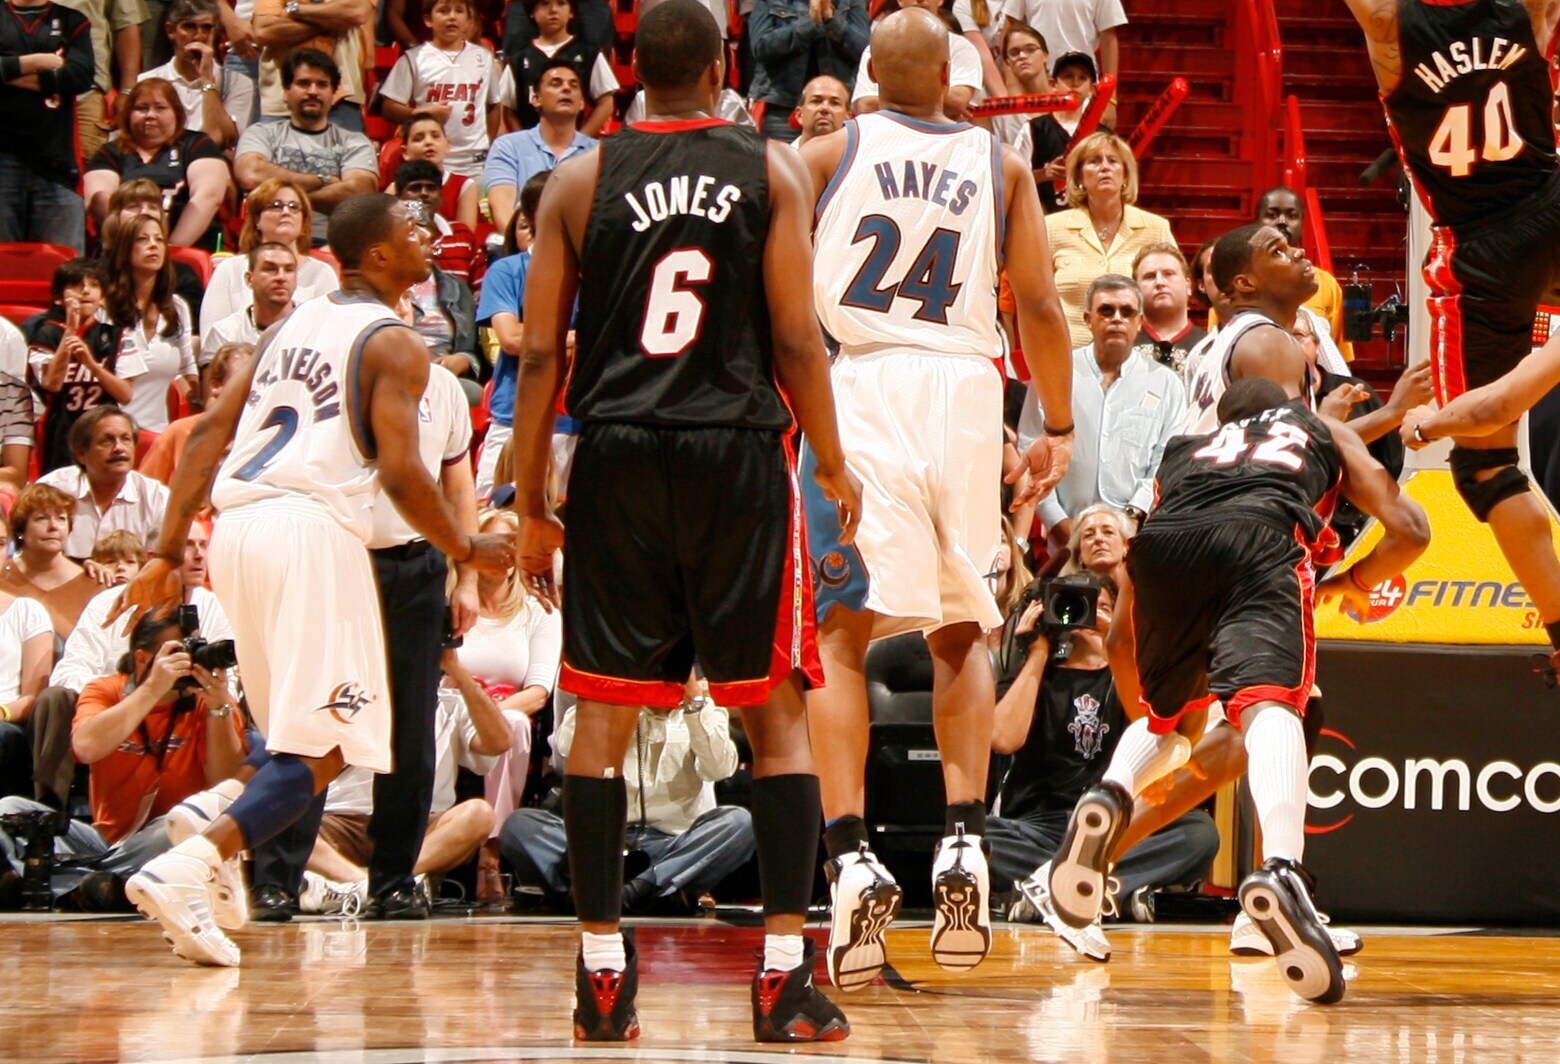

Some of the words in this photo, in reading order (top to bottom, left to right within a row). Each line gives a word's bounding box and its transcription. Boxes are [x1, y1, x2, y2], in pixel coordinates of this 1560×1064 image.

[426, 79, 483, 104] HEAT
[462, 103, 476, 127] 3
[1022, 94, 1071, 110] HEAT
[1427, 80, 1524, 178] 40
[624, 174, 742, 233] JONES
[873, 159, 978, 216] HAYES
[839, 213, 962, 326] 24
[640, 247, 715, 357] 6
[66, 385, 102, 412] 32
[226, 406, 300, 483] 2
[1189, 418, 1312, 472] 42
